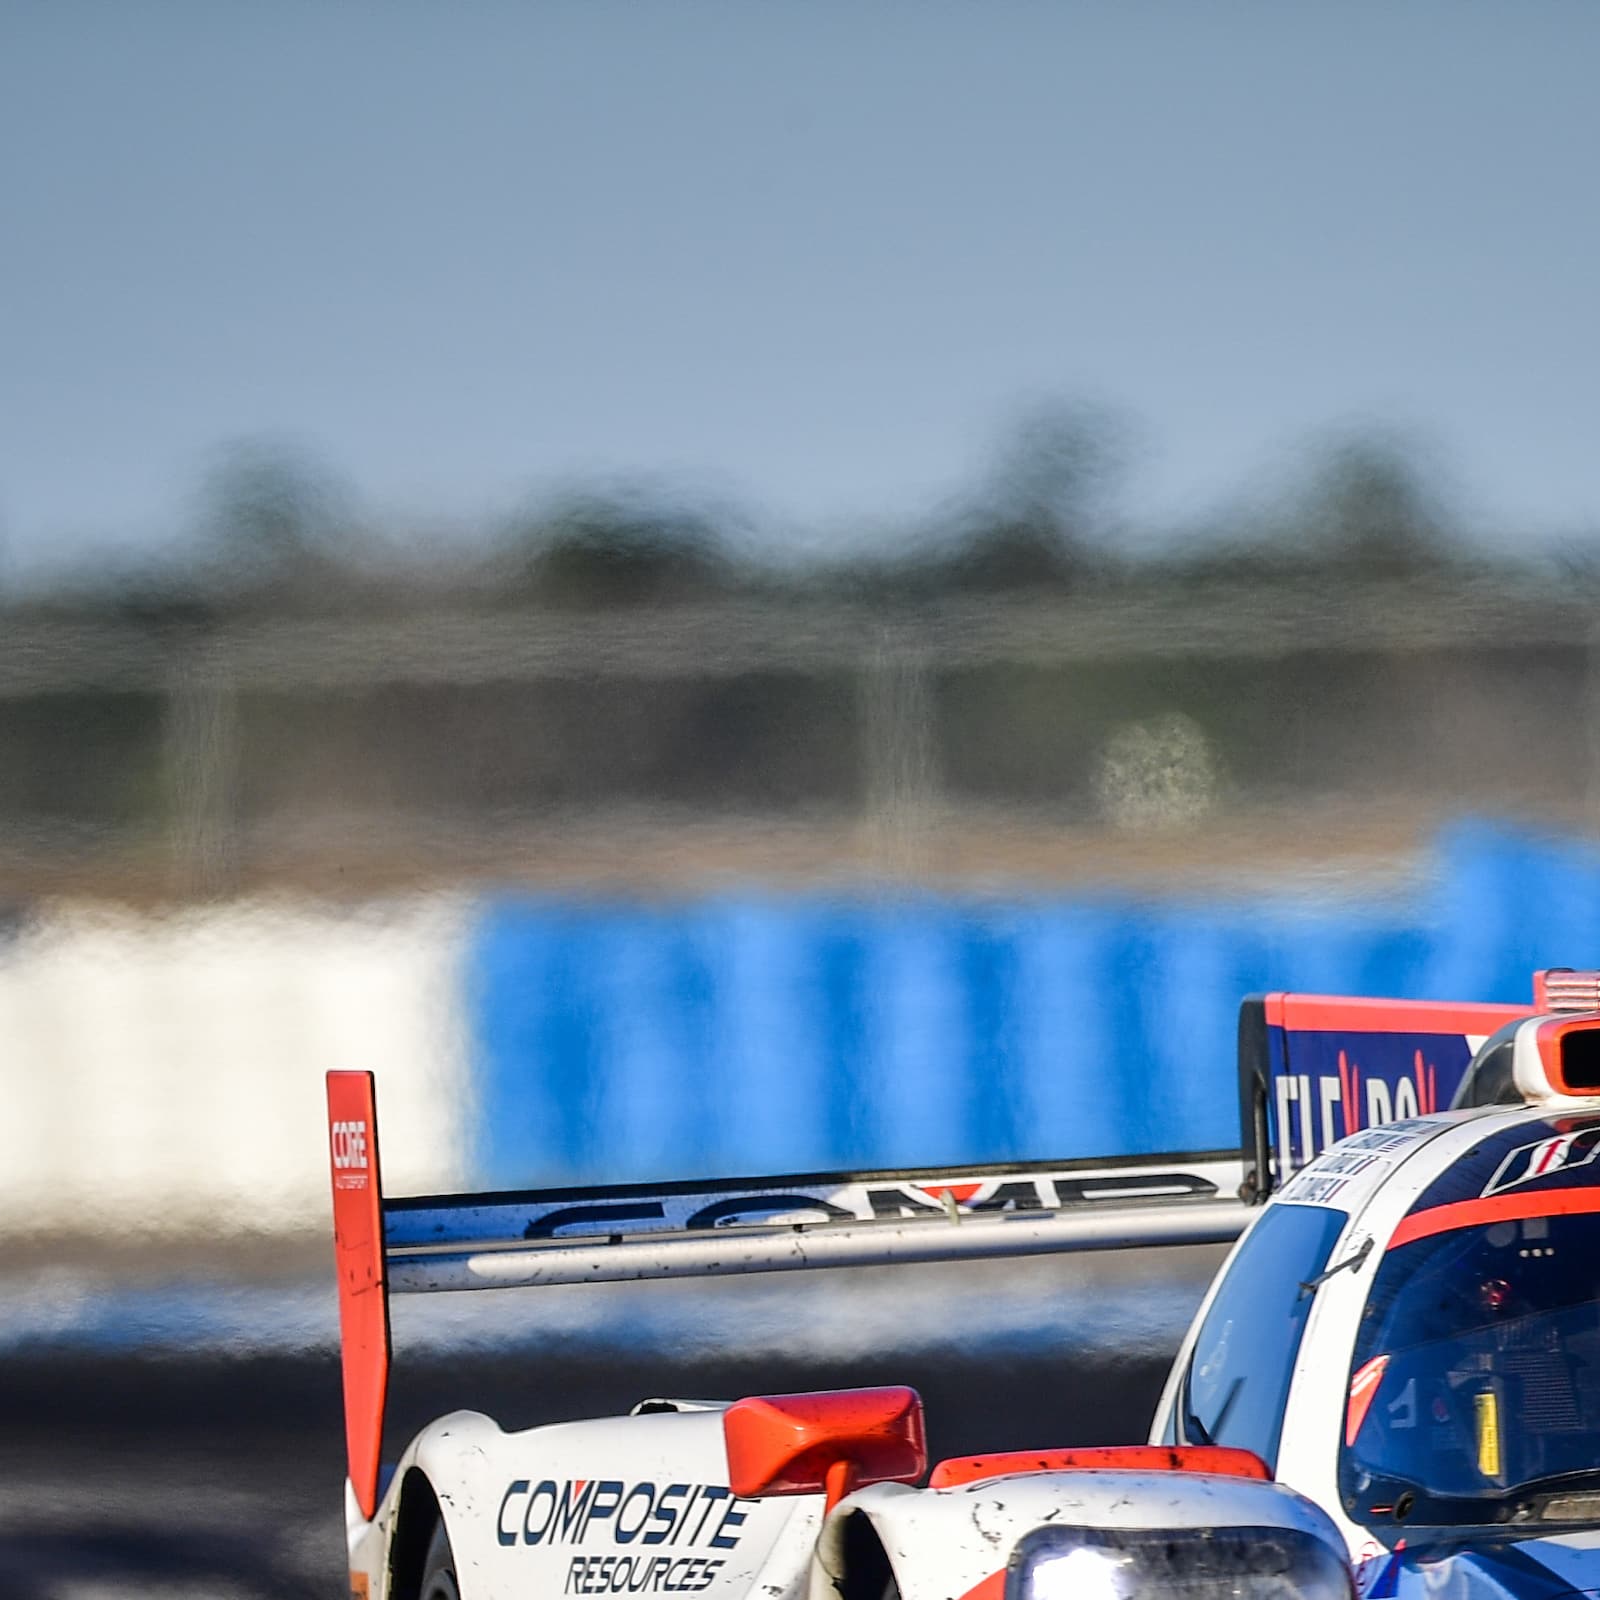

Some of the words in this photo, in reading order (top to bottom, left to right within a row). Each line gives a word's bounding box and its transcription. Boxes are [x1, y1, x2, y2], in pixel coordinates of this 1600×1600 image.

[332, 1121, 368, 1169] CORE
[496, 1479, 762, 1550] COMPOSITE
[564, 1556, 727, 1595] RESOURCES
